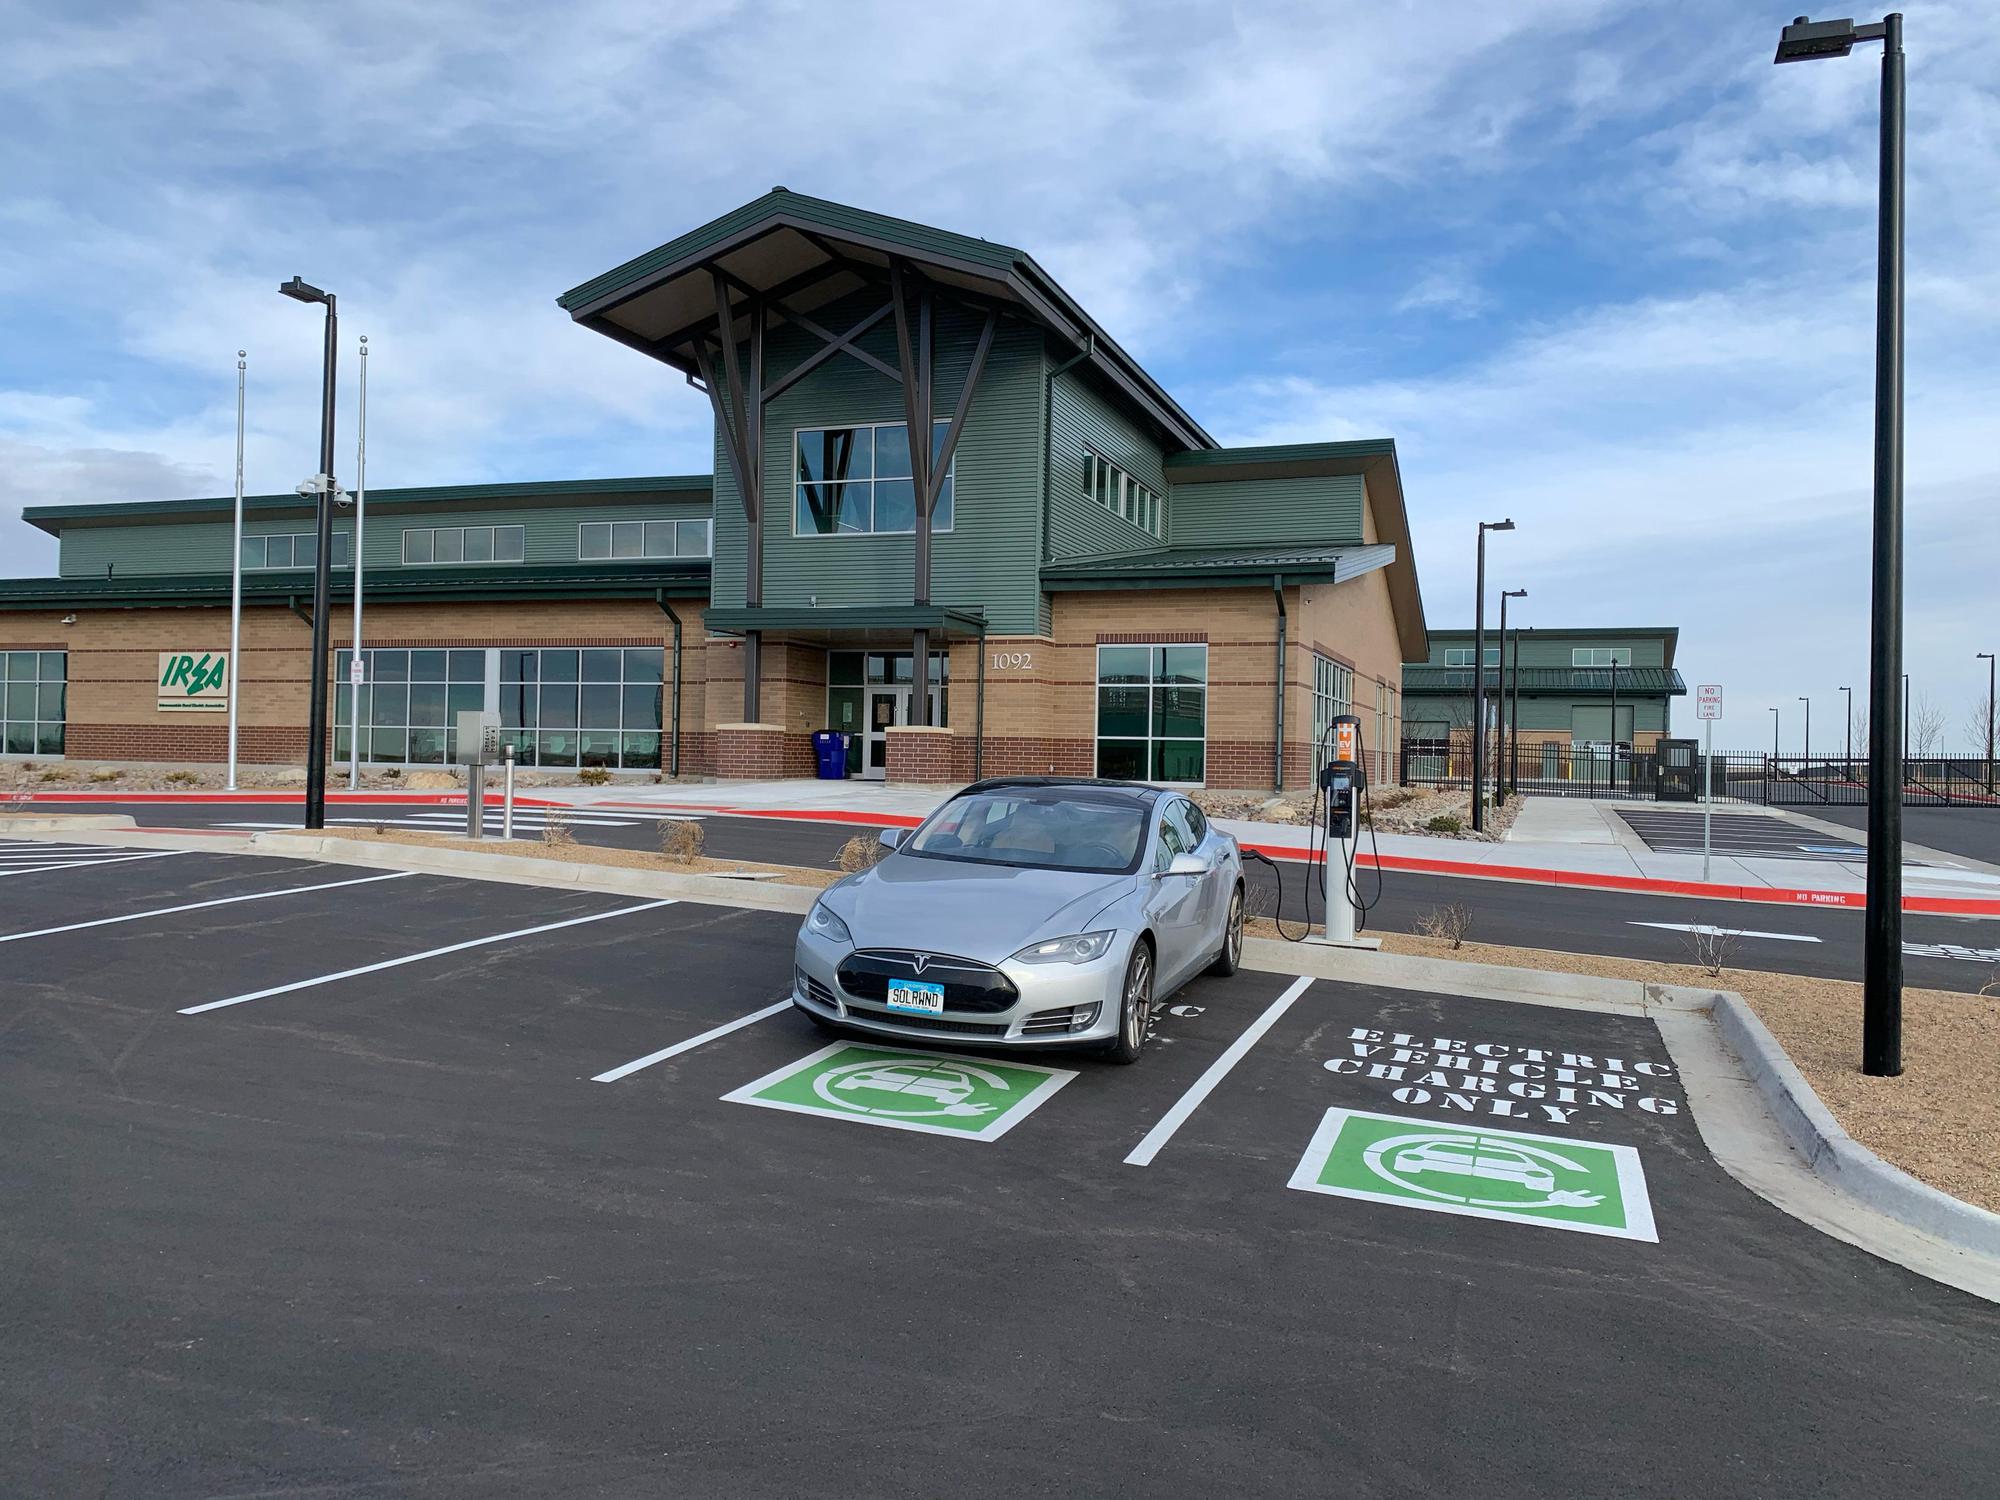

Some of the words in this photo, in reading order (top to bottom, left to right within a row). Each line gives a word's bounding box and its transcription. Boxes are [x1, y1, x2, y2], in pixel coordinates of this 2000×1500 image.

[991, 653, 1033, 670] 1092
[1704, 687, 1715, 695] NO
[1339, 740, 1351, 748] EV
[1796, 893, 1808, 901] NO
[1811, 894, 1846, 904] PARKING
[892, 988, 939, 1008] SOLRWND
[1347, 1027, 1673, 1077] ELECTRIC
[1351, 1042, 1640, 1091] VEHICLE
[1323, 1058, 1679, 1115] CHARGING
[1392, 1087, 1579, 1124] ONLY
